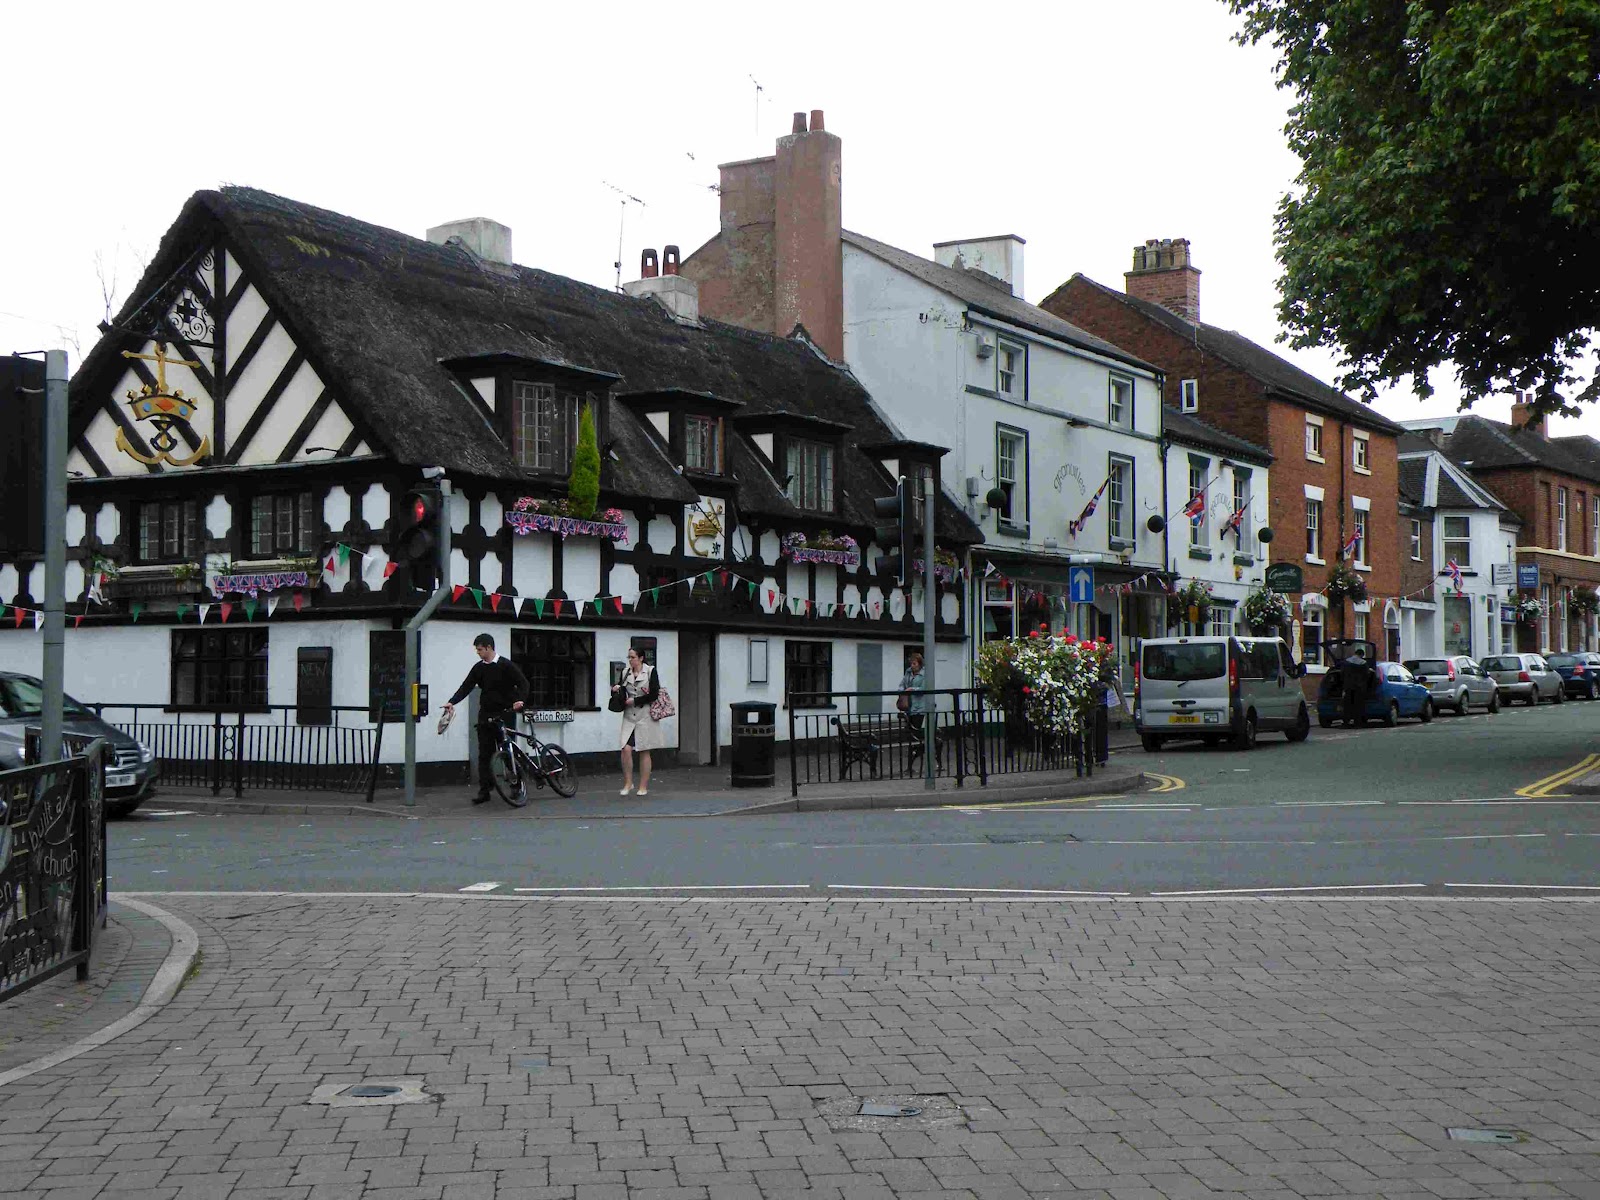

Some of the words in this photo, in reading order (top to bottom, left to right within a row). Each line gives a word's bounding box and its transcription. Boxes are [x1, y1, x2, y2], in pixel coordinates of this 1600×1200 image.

[555, 711, 573, 721] Road
[28, 801, 53, 852] built
[43, 842, 78, 877] church
